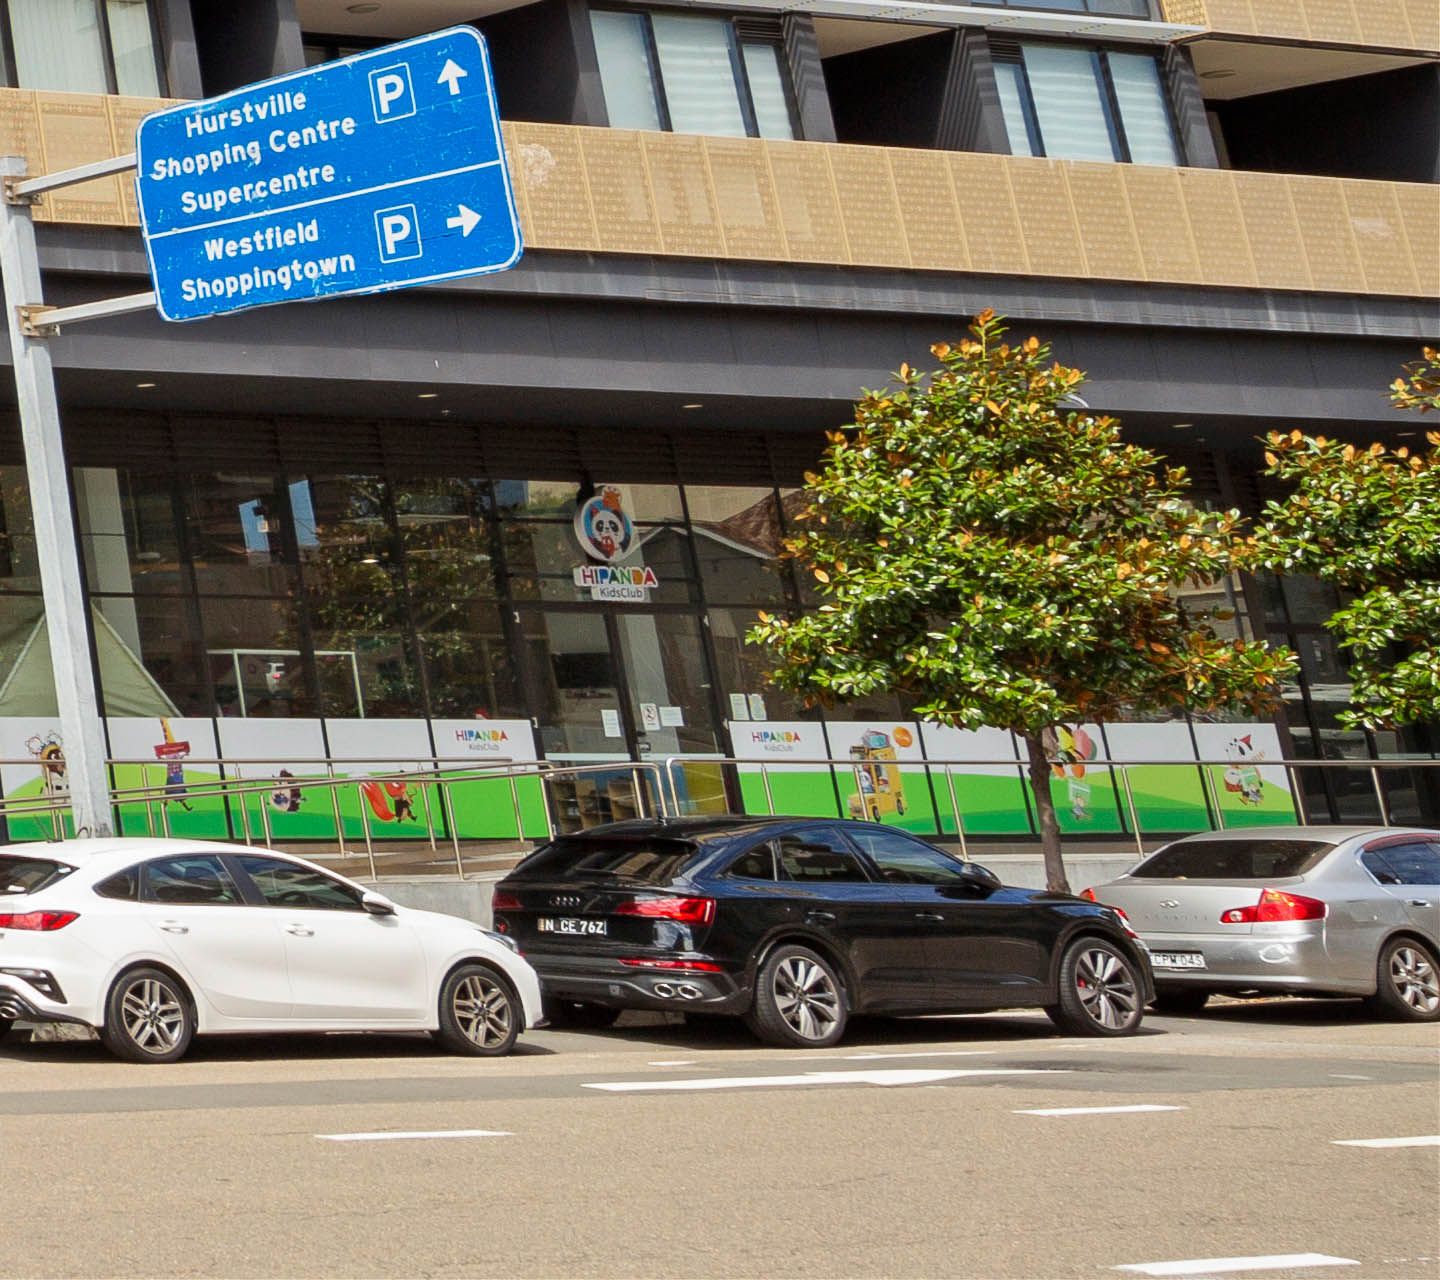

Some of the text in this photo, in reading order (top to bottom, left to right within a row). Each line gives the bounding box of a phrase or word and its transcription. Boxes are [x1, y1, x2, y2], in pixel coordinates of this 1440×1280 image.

[376, 74, 405, 114] P
[185, 91, 307, 138] Hurstville
[151, 117, 356, 181] Shopping Centre
[181, 164, 335, 214] Supercentre
[204, 219, 319, 261] Westfield
[382, 214, 411, 254] P
[181, 253, 356, 301] Shoppingtown
[582, 567, 657, 585] HIPANDA
[600, 588, 643, 598] KidsClub
[455, 730, 509, 741] HIPANDA
[752, 731, 801, 743] HIPANDA
[580, 920, 605, 934] 76Z
